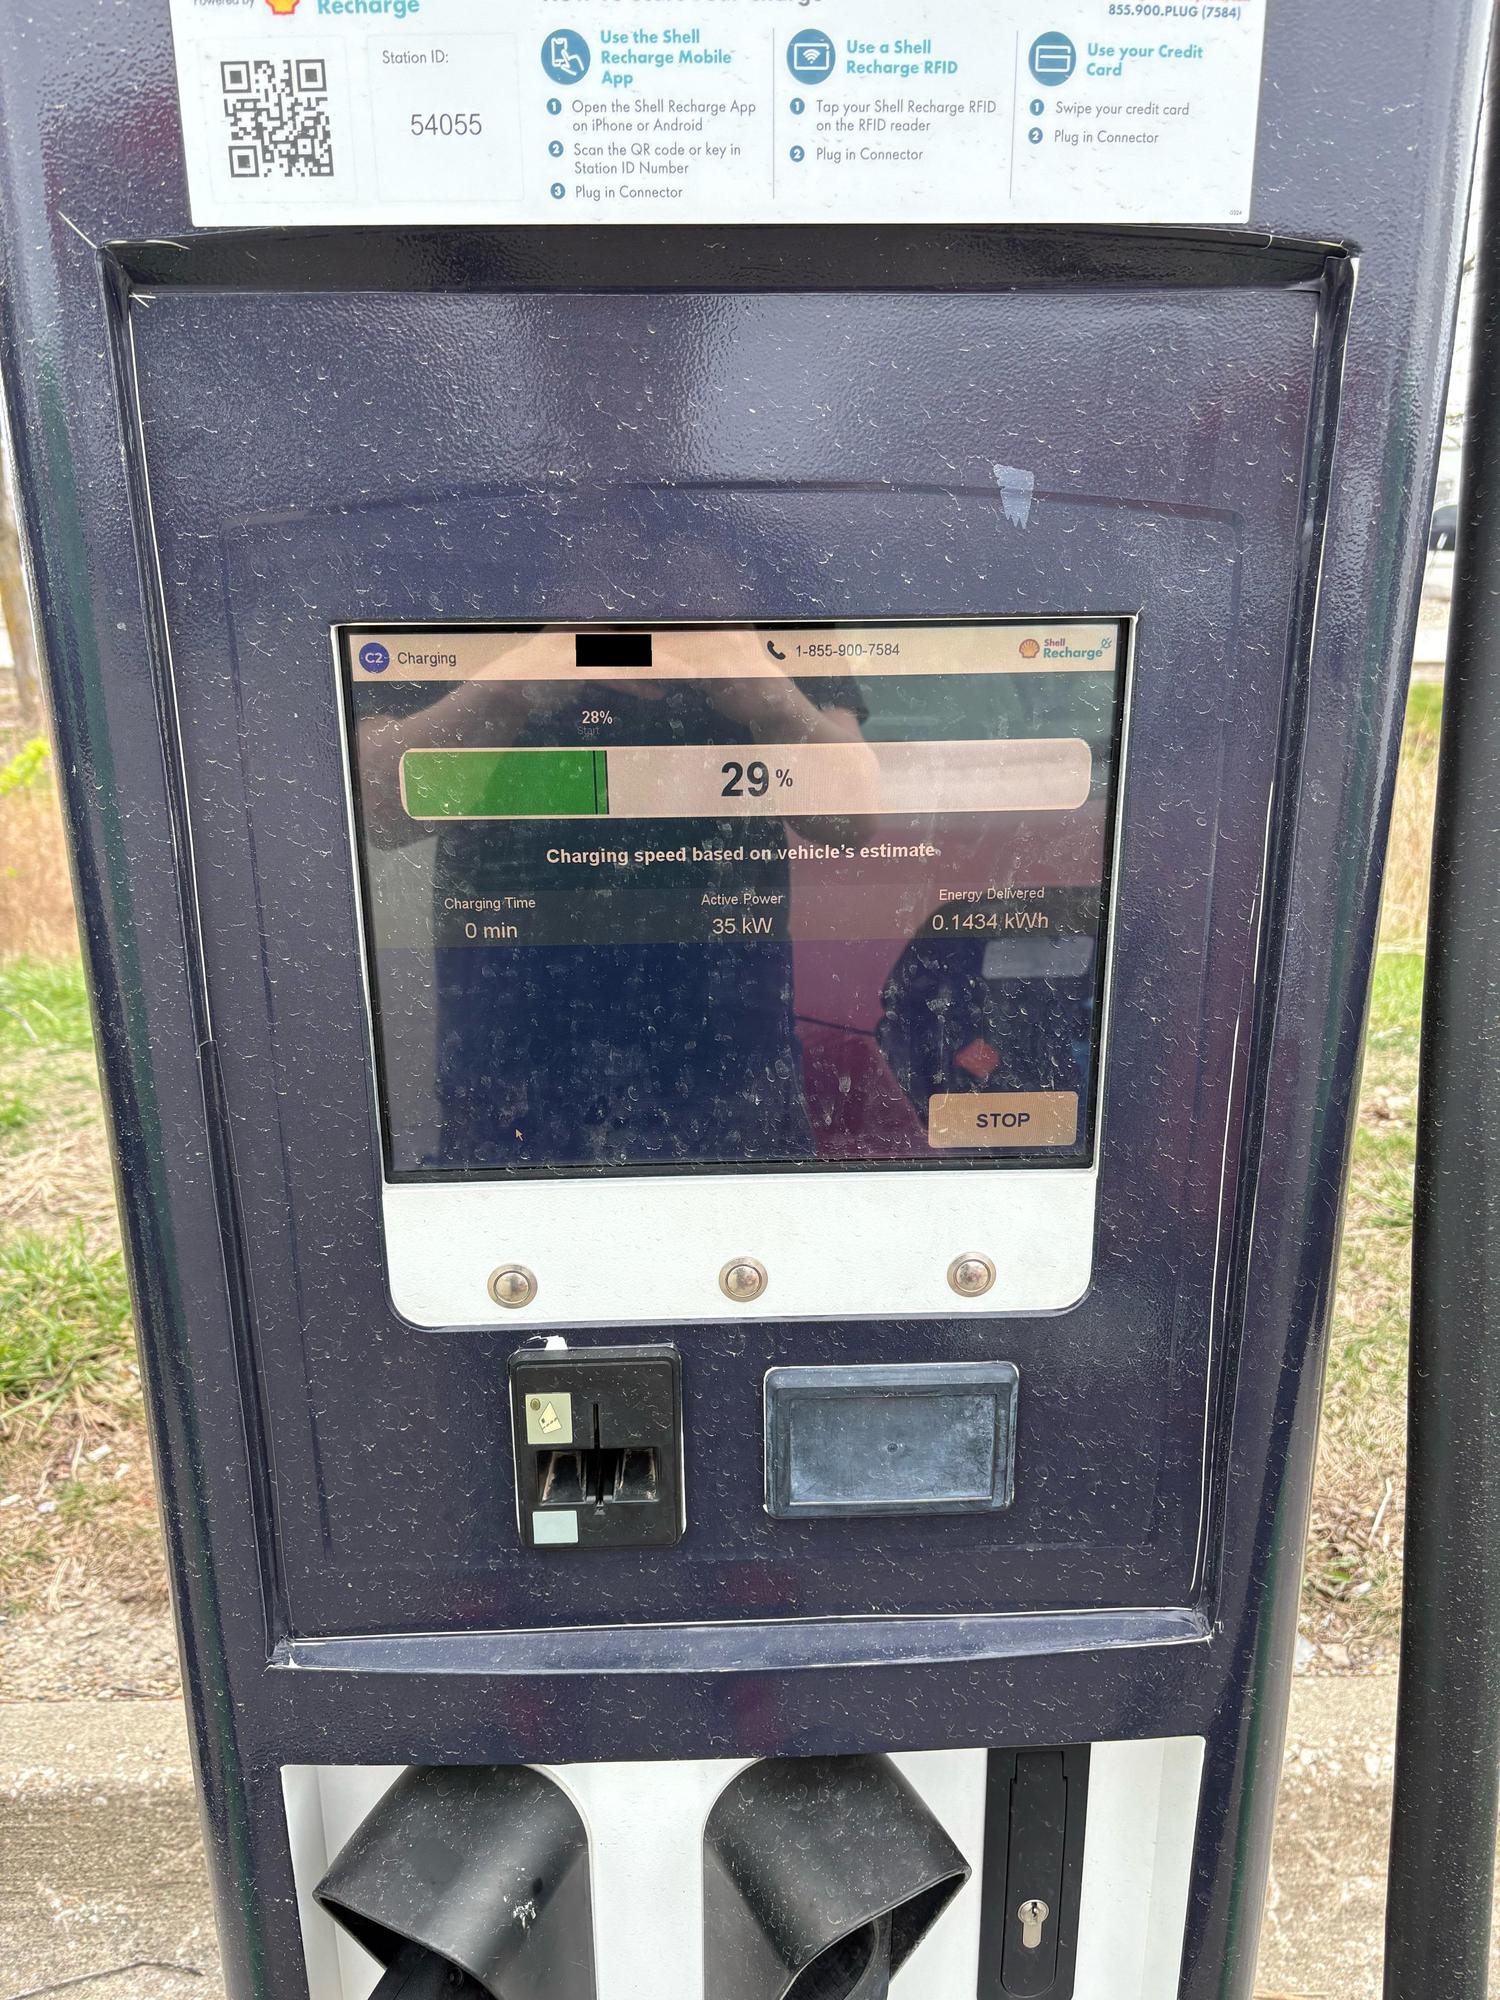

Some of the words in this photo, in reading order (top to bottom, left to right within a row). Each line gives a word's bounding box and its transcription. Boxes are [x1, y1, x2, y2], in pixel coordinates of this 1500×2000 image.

[318, 0, 420, 18] Recharge
[1108, 4, 1199, 17] 855.900.PLUG
[1201, 5, 1241, 20] (7584)
[600, 30, 629, 43] Use
[632, 29, 658, 43] the
[663, 29, 700, 43] Shell
[846, 40, 876, 54] Use
[879, 44, 889, 54] a
[894, 39, 931, 54] Shell
[1088, 43, 1115, 56] Use
[1119, 47, 1154, 61] your
[1158, 44, 1204, 59] Credit
[382, 50, 427, 64] Station
[431, 50, 449, 63] ID:
[601, 49, 674, 67] Recharge
[678, 49, 732, 63] Mobile
[846, 60, 920, 77] Recharge
[924, 60, 958, 74] RFID
[1086, 62, 1122, 76] Card
[601, 71, 633, 88] App
[572, 100, 607, 116] Open
[611, 99, 630, 113] the
[634, 99, 664, 113] Shell
[668, 99, 726, 116] Recharge
[730, 100, 756, 117] App
[816, 100, 839, 116] Tap
[843, 104, 869, 117] your
[874, 99, 904, 113] Shell
[908, 99, 965, 116] Recharge
[969, 100, 996, 113] RFID
[1055, 101, 1092, 117] Swipe
[1096, 105, 1121, 118] your
[1125, 102, 1159, 115] credit
[1163, 102, 1190, 116] card
[411, 113, 482, 136] 54055
[572, 121, 588, 131] on
[592, 118, 632, 131] iPhone
[637, 121, 650, 131] or
[653, 117, 703, 131] Android
[816, 121, 831, 131] on
[835, 118, 854, 131] the
[859, 118, 886, 131] RFID
[890, 118, 931, 131] reader
[1054, 130, 1079, 145] Plug
[1083, 131, 1093, 143] in
[1097, 130, 1159, 143] Connector
[574, 143, 604, 156] Scan
[608, 142, 627, 156] the
[631, 143, 650, 157] QR
[654, 142, 685, 156] code
[689, 145, 701, 156] or
[706, 142, 726, 159] key
[730, 143, 741, 156] in
[816, 147, 841, 163] Plug
[846, 148, 856, 160] in
[860, 147, 923, 160] Connector
[574, 161, 617, 174] Station
[622, 162, 635, 174] ID
[639, 161, 689, 174] Number
[575, 185, 600, 201] Plug
[605, 185, 615, 198] in
[619, 185, 683, 198] Connector
[796, 642, 900, 658] 1-855-900-7584
[1044, 638, 1066, 647] Shell
[365, 652, 384, 664] C2
[397, 651, 457, 667] Charging
[1043, 646, 1103, 660] Recharge
[582, 710, 613, 725] 28%
[546, 848, 629, 866] Charging
[634, 847, 687, 865] speed
[692, 846, 744, 861] based
[749, 848, 772, 860] on
[860, 842, 935, 857] estimate
[701, 893, 738, 905] Active
[743, 893, 783, 905] Power
[939, 888, 982, 902] Energy
[987, 886, 1045, 900] Delivered
[444, 897, 501, 912] Charging
[504, 896, 537, 909] Time
[712, 918, 736, 934] 35
[742, 917, 773, 934] kW
[932, 913, 998, 931] 0.1434
[1004, 911, 1049, 929] kWh
[465, 923, 477, 939] 0
[483, 922, 518, 939] min
[976, 1112, 1030, 1128] STOP
